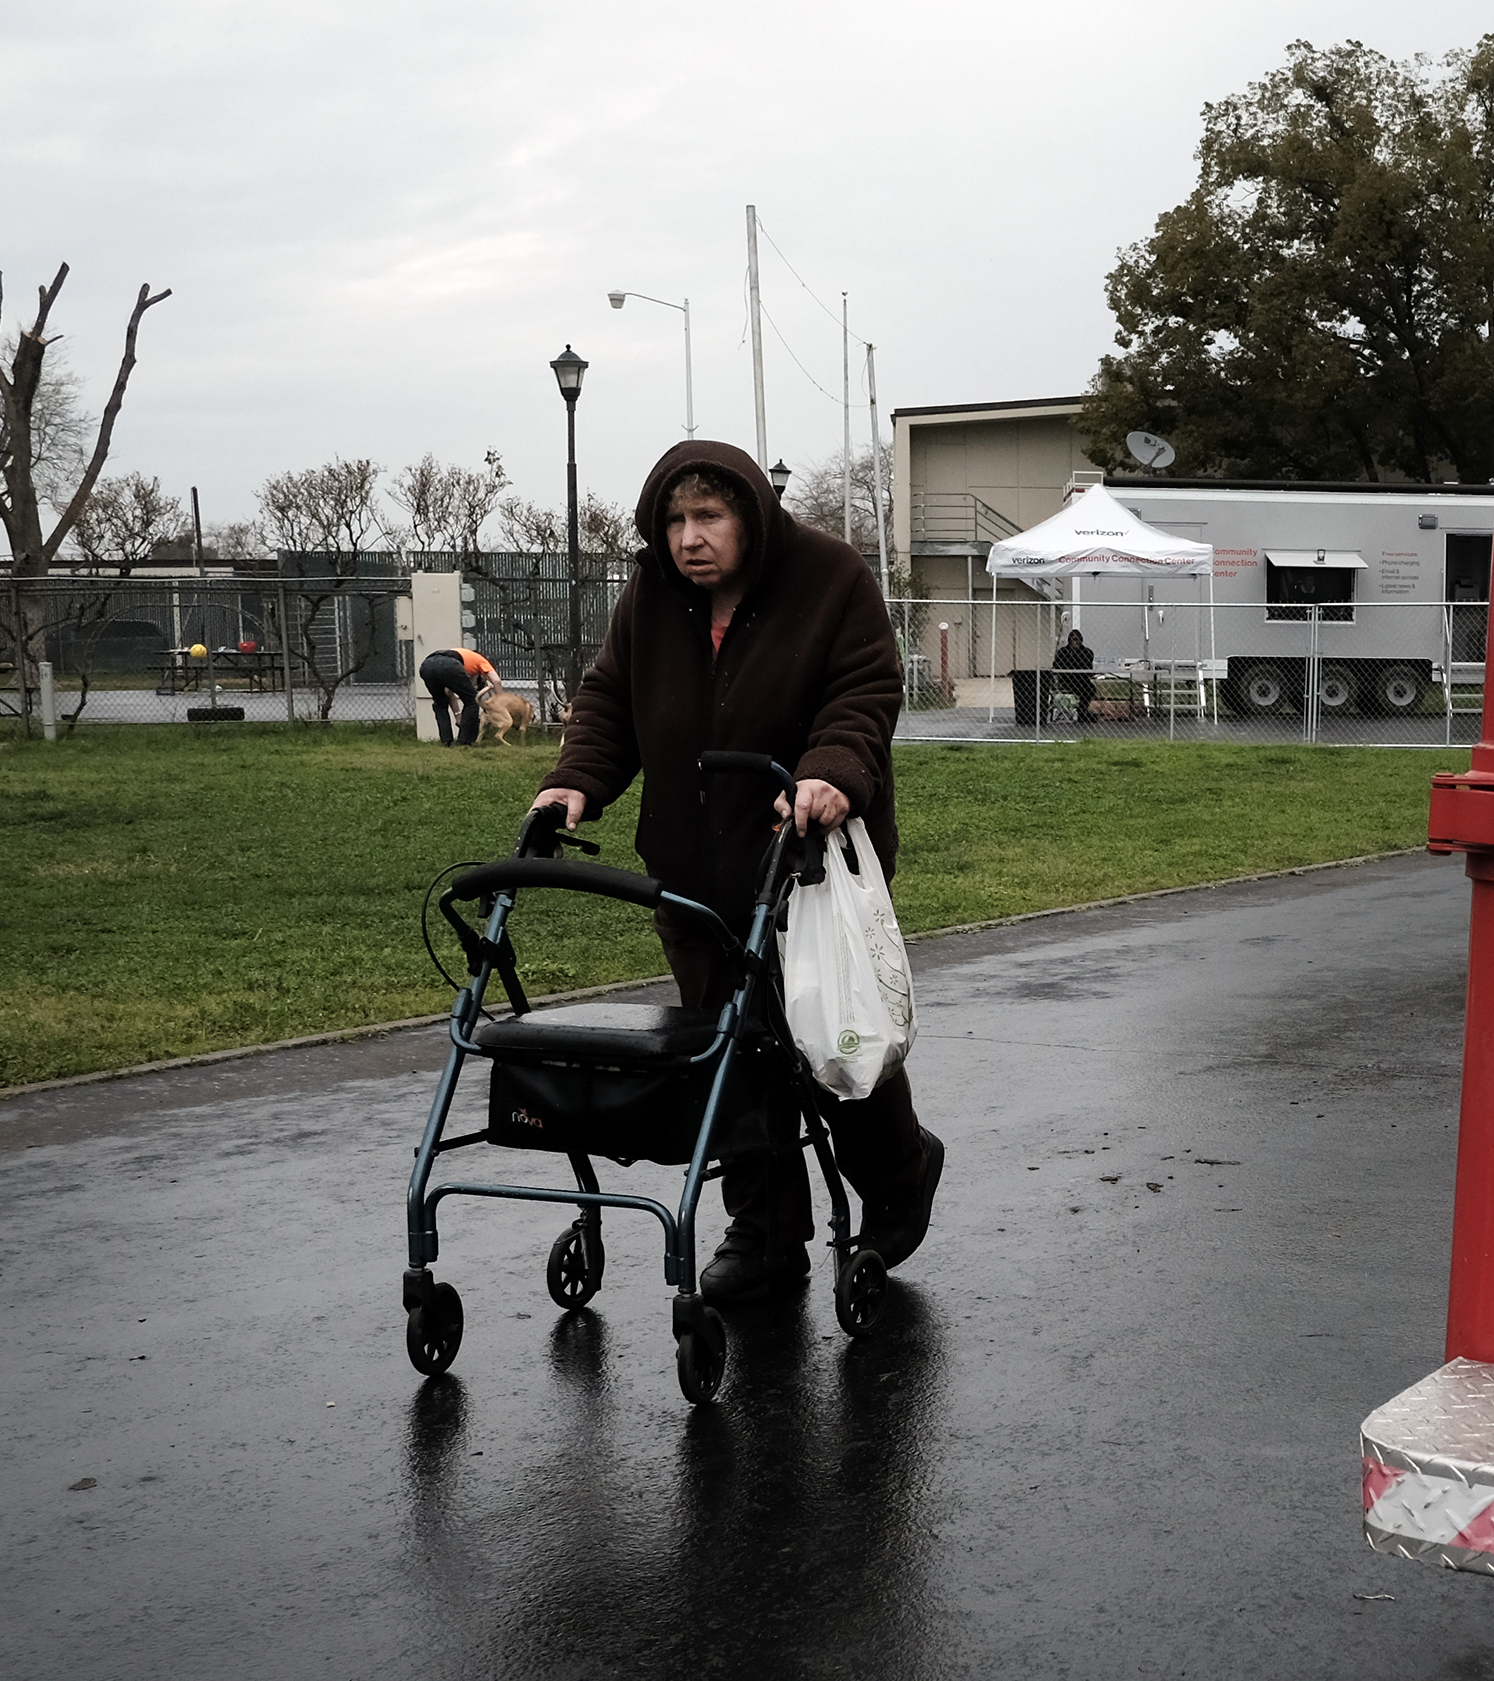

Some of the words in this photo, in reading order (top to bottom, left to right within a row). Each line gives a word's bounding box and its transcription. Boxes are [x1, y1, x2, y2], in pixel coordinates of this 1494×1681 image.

[1074, 529, 1124, 537] verizon
[1011, 556, 1046, 565] verizon
[1058, 553, 1110, 563] Community
[1111, 554, 1164, 565] Connection
[1165, 557, 1195, 565] Center
[1213, 548, 1258, 567] ommunity
